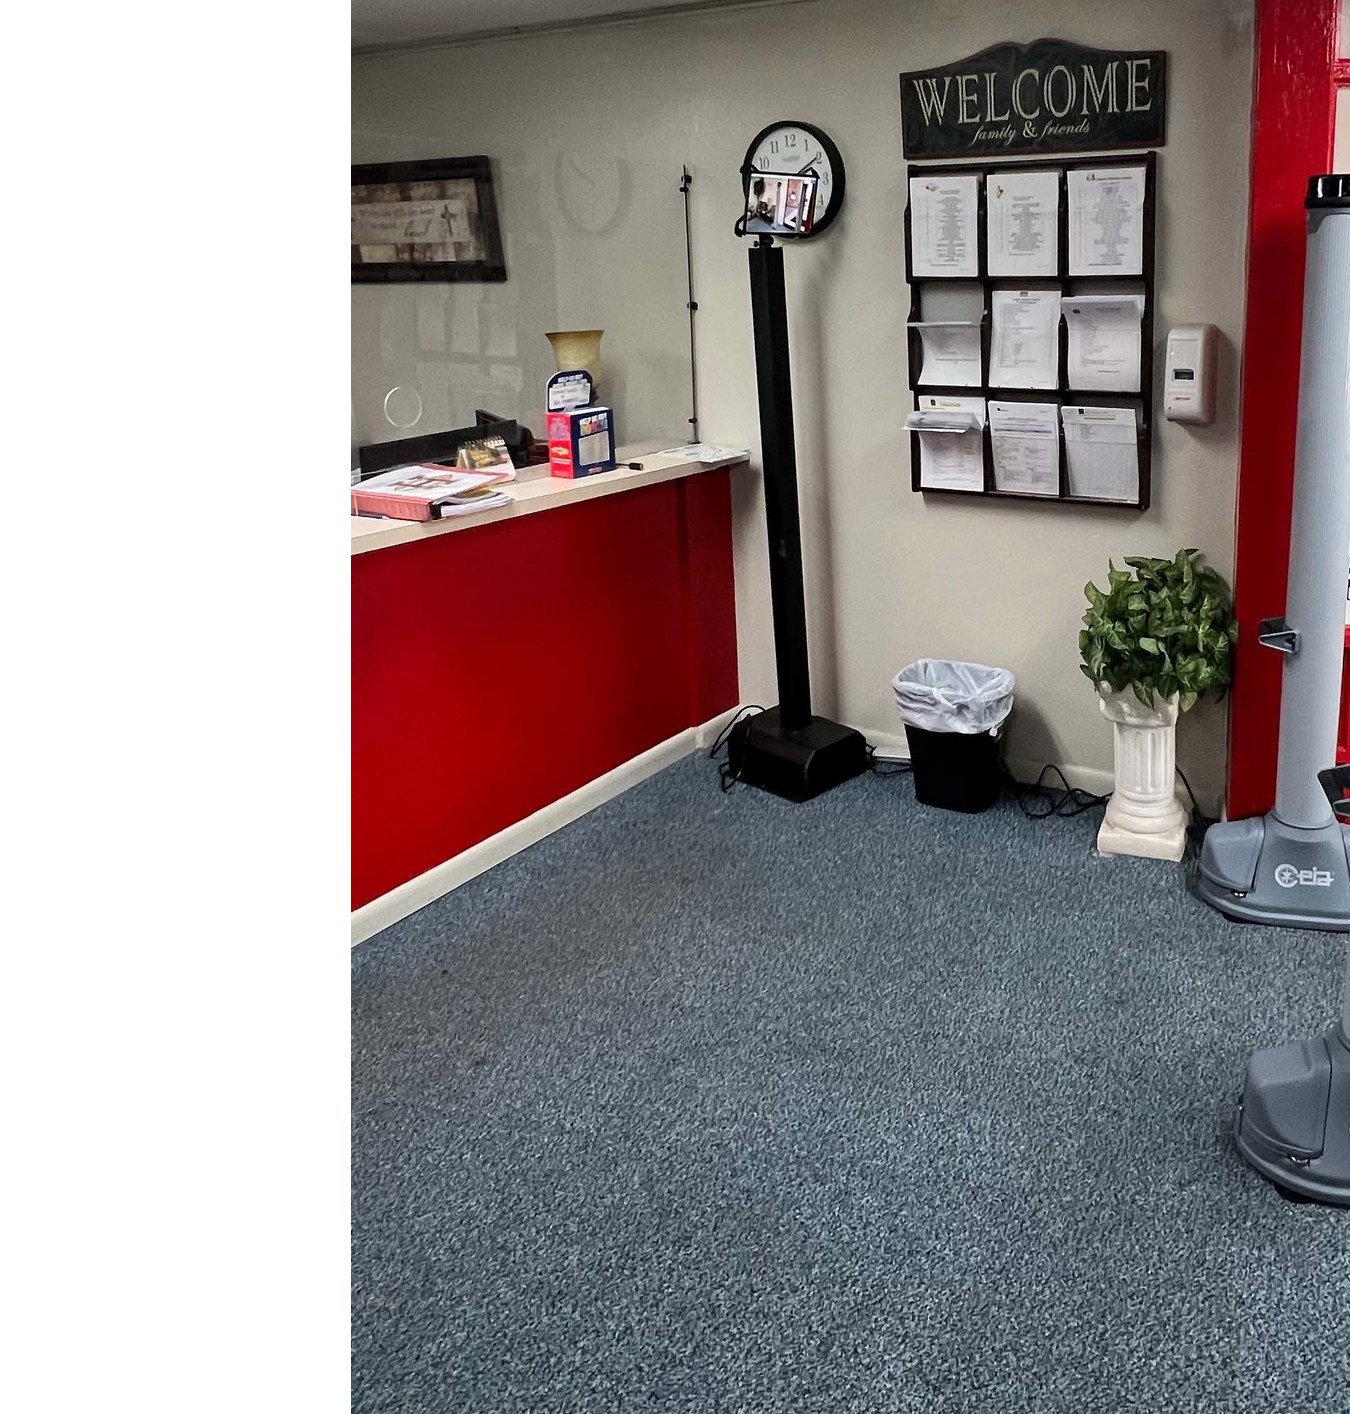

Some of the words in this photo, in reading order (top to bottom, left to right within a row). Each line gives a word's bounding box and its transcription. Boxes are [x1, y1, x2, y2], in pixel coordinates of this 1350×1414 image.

[912, 58, 1152, 126] WELCOME
[966, 123, 1016, 148] family
[1022, 120, 1038, 138] &
[1039, 118, 1090, 140] friends
[770, 140, 779, 154] 11
[784, 134, 797, 148] 12
[804, 139, 809, 152] 1
[759, 156, 770, 170] 10
[816, 151, 823, 165] 2
[822, 172, 829, 185] 3
